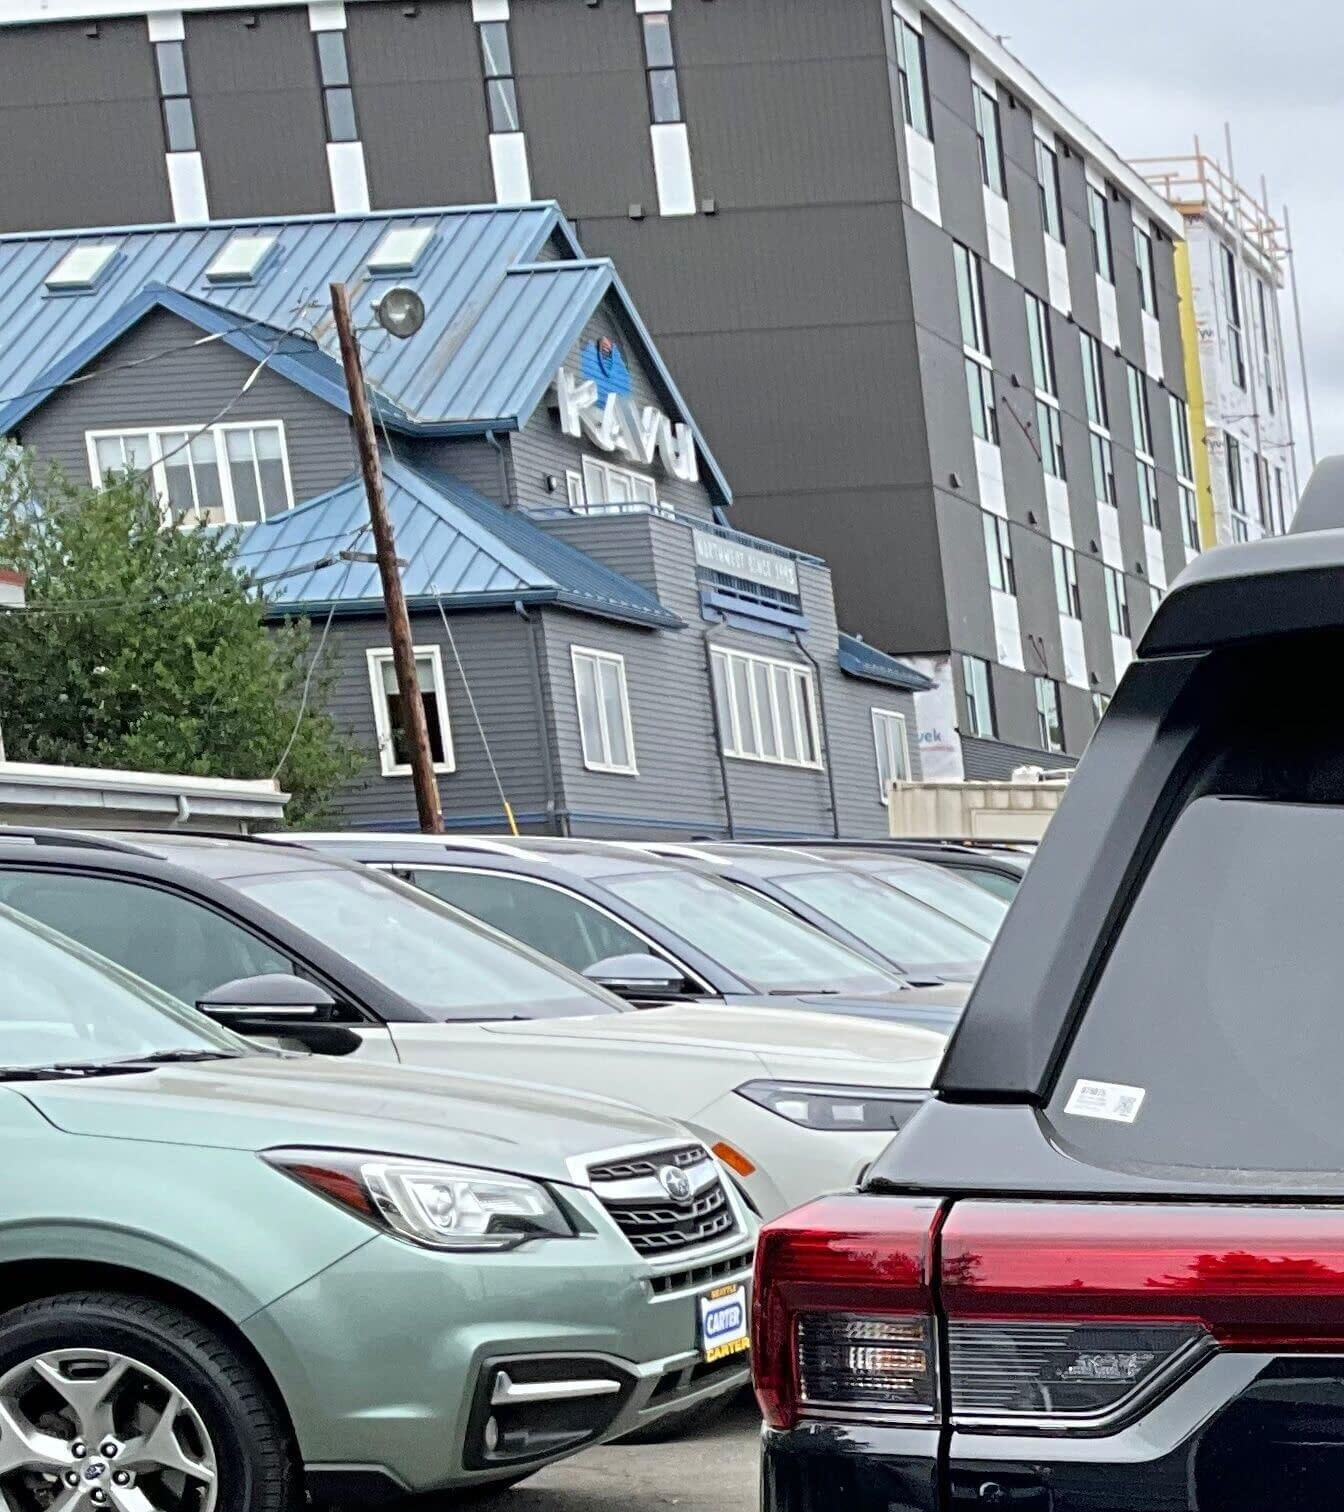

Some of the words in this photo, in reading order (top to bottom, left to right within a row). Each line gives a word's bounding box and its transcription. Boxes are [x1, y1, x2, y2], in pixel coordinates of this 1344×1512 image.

[558, 366, 699, 482] KAVU
[707, 1308, 740, 1334] CARTER
[707, 1337, 750, 1361] CARTER
